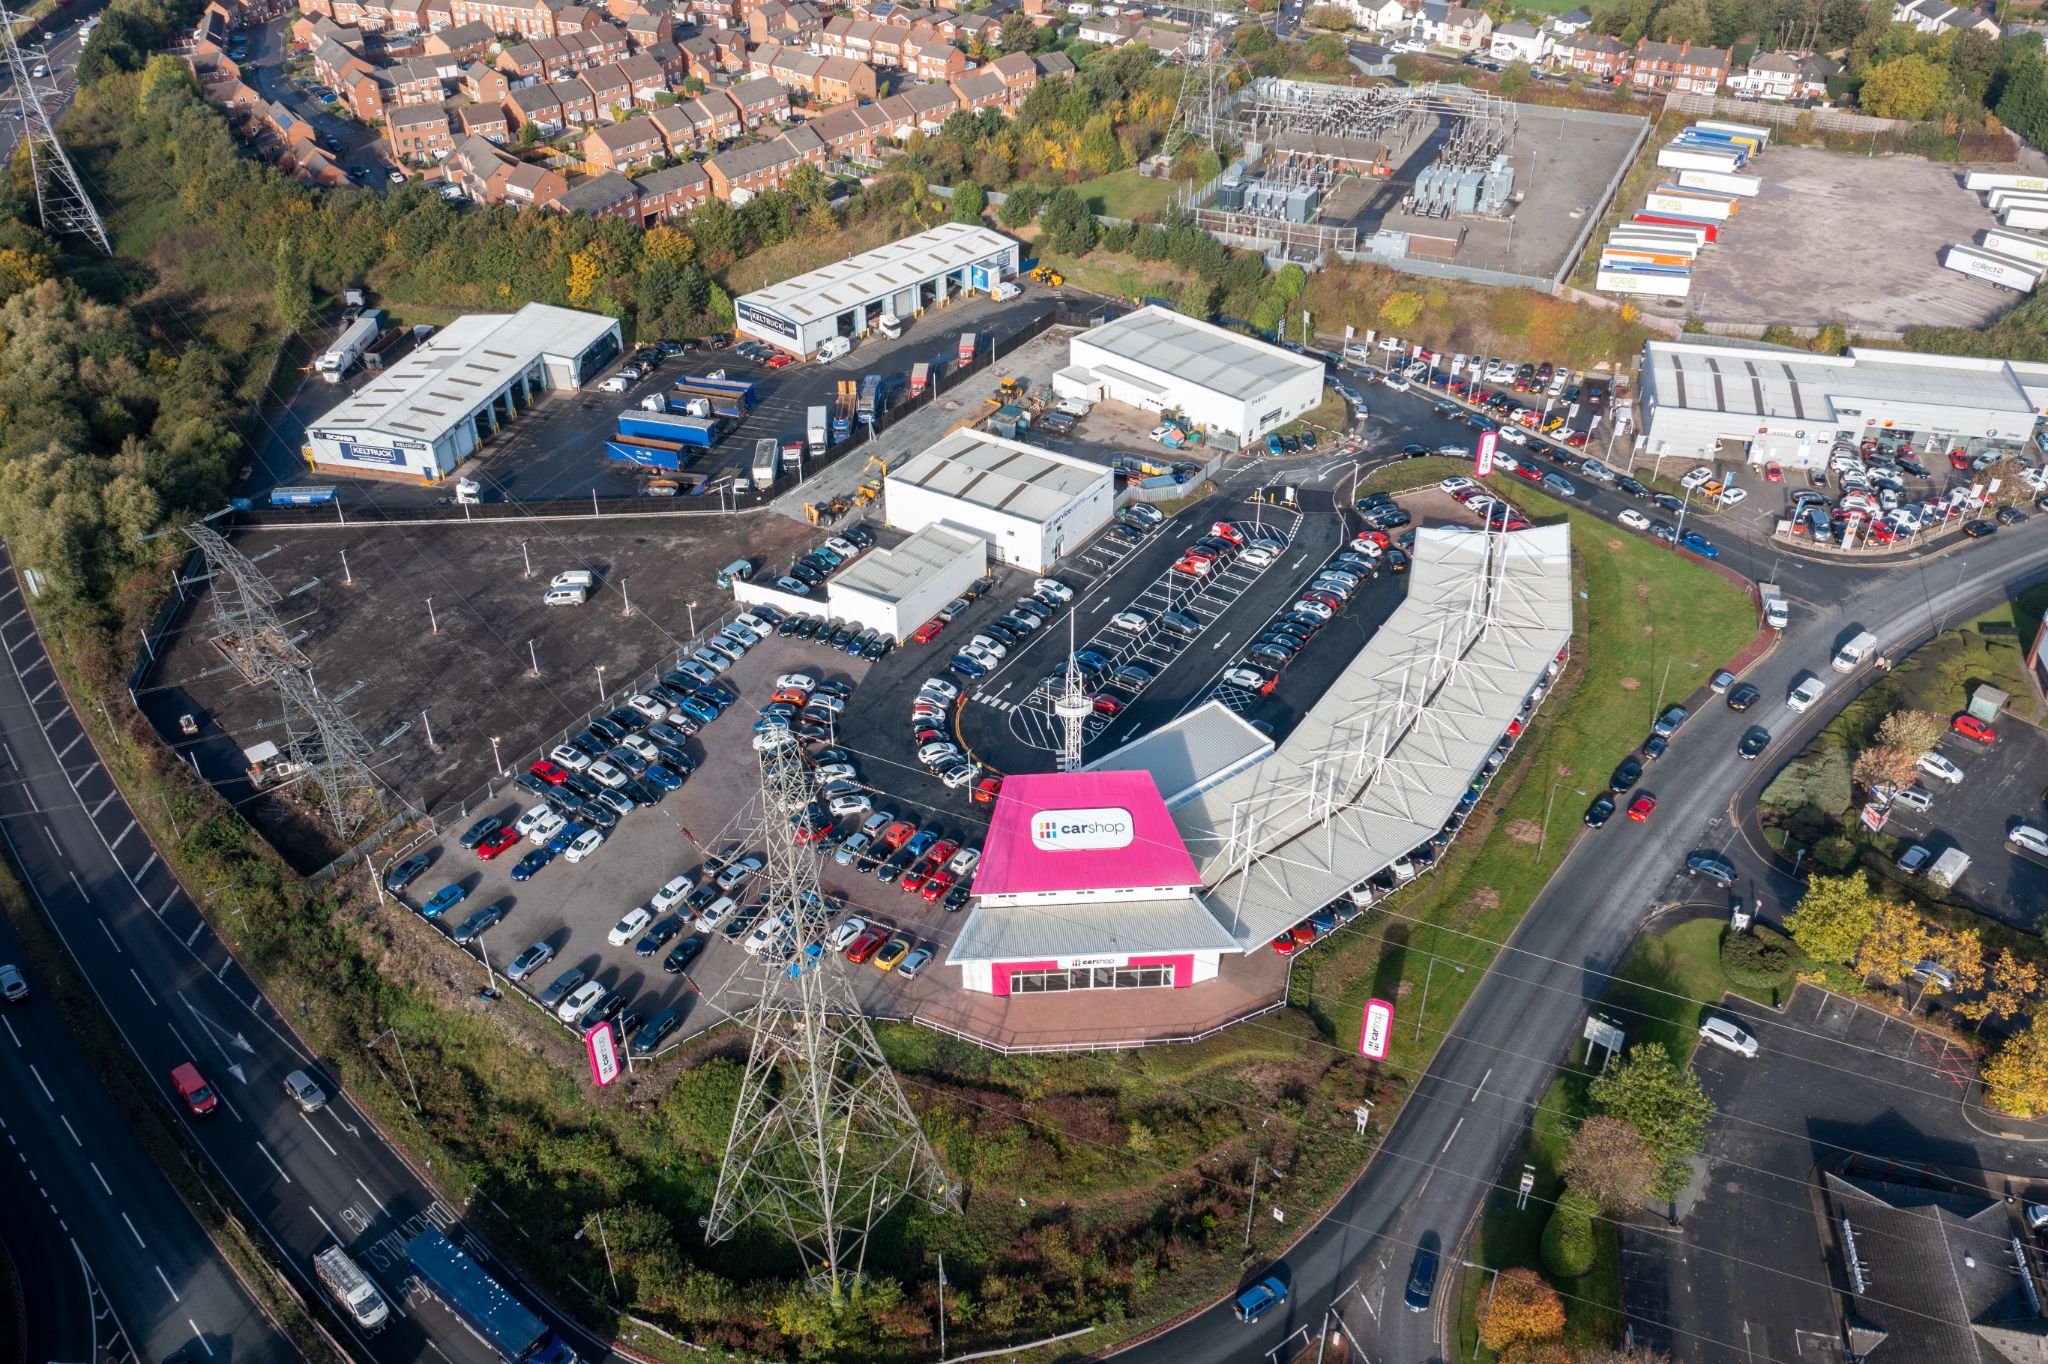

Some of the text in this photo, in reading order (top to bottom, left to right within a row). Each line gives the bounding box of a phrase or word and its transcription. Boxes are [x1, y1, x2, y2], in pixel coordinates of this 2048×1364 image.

[2016, 179, 2044, 188] YODEL
[325, 433, 355, 442] SCANIA
[353, 446, 394, 458] KELTRUCK
[1061, 821, 1126, 836] carshop
